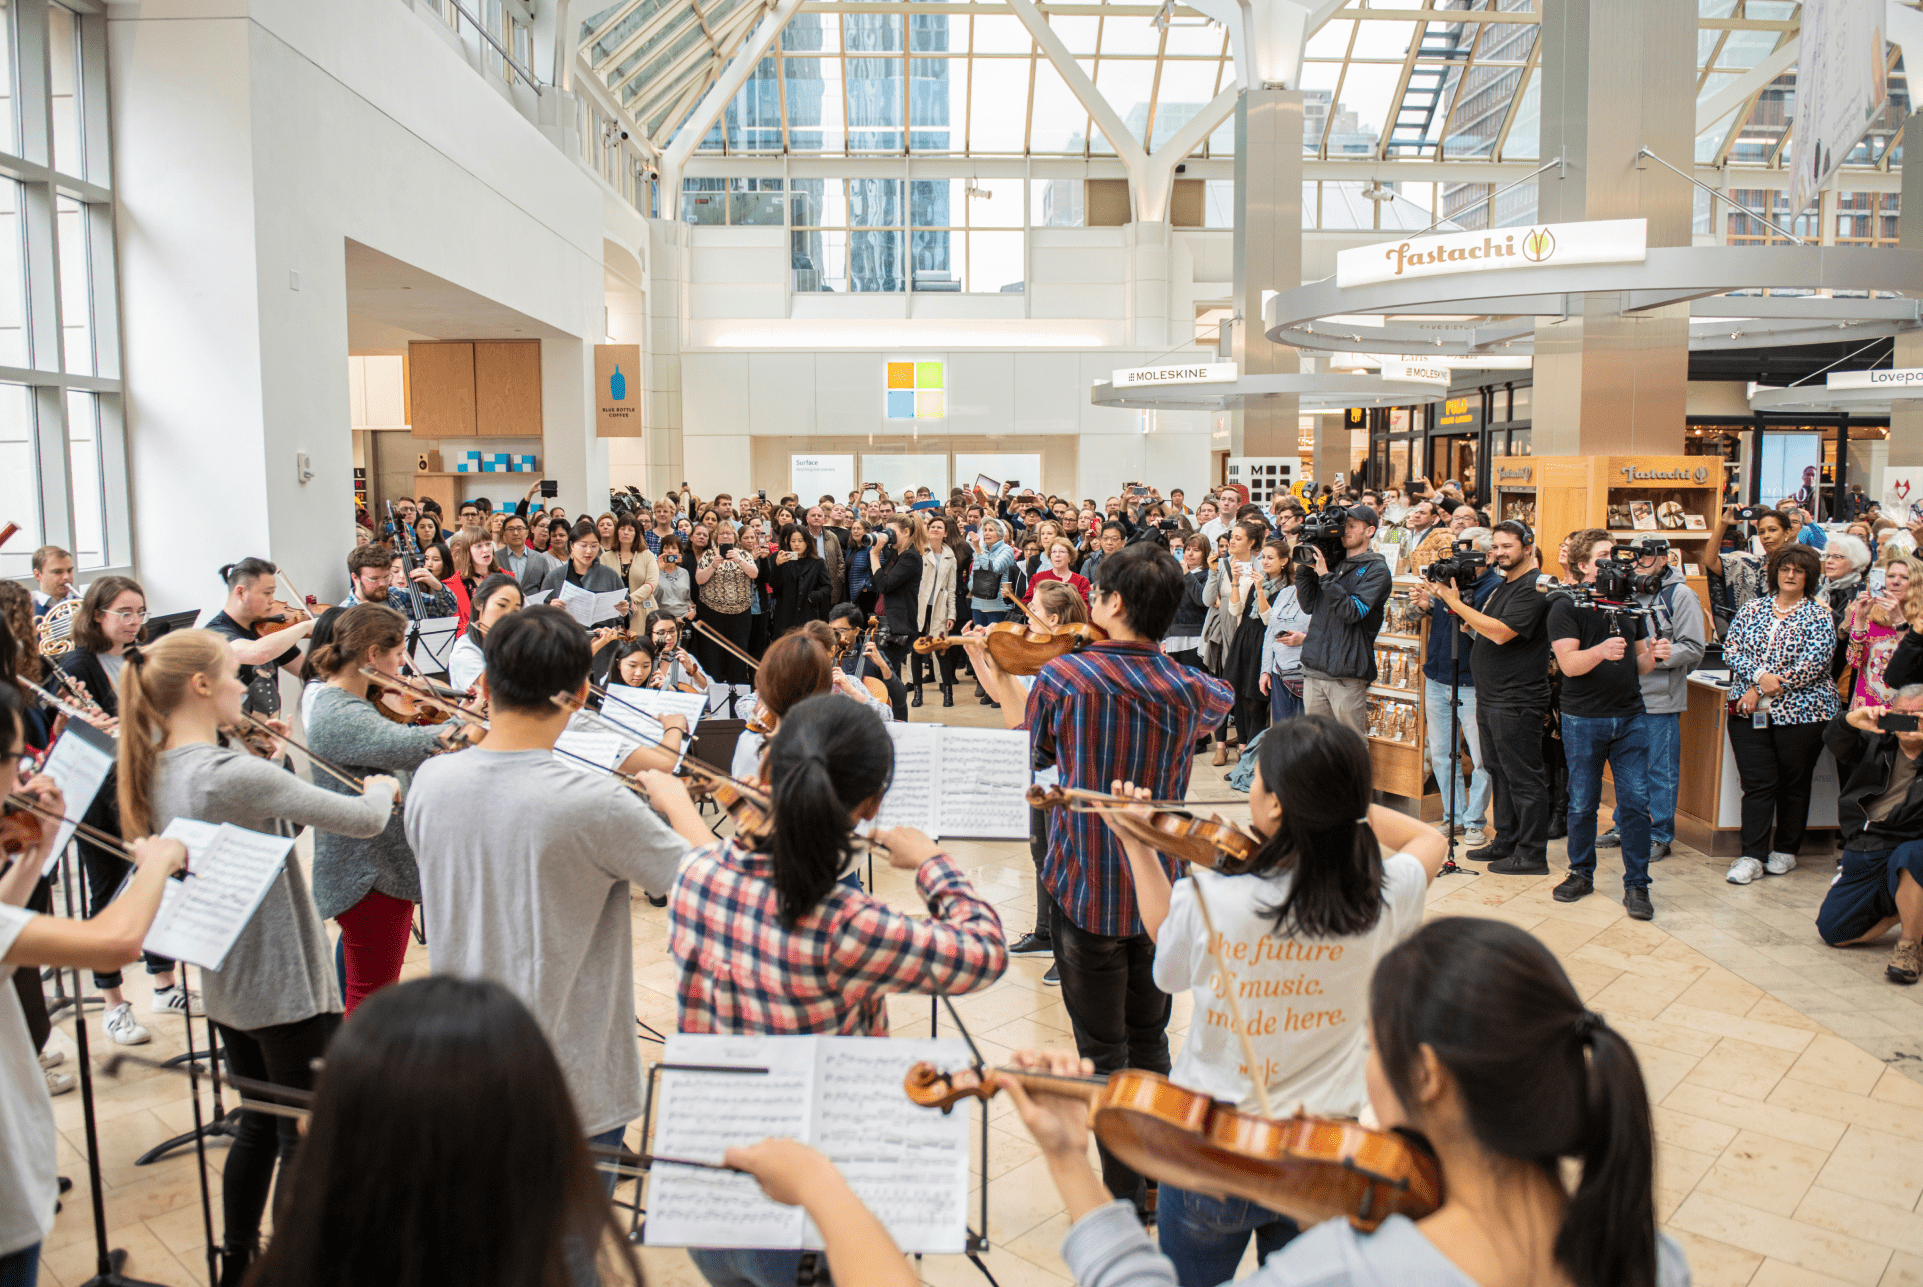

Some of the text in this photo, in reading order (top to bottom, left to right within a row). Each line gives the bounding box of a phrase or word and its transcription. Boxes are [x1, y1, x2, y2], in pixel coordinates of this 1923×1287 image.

[1136, 368, 1207, 382] MOLESKINE
[1208, 932, 1344, 967] he future
[1239, 973, 1324, 999] music.
[1283, 1007, 1346, 1032] here.
